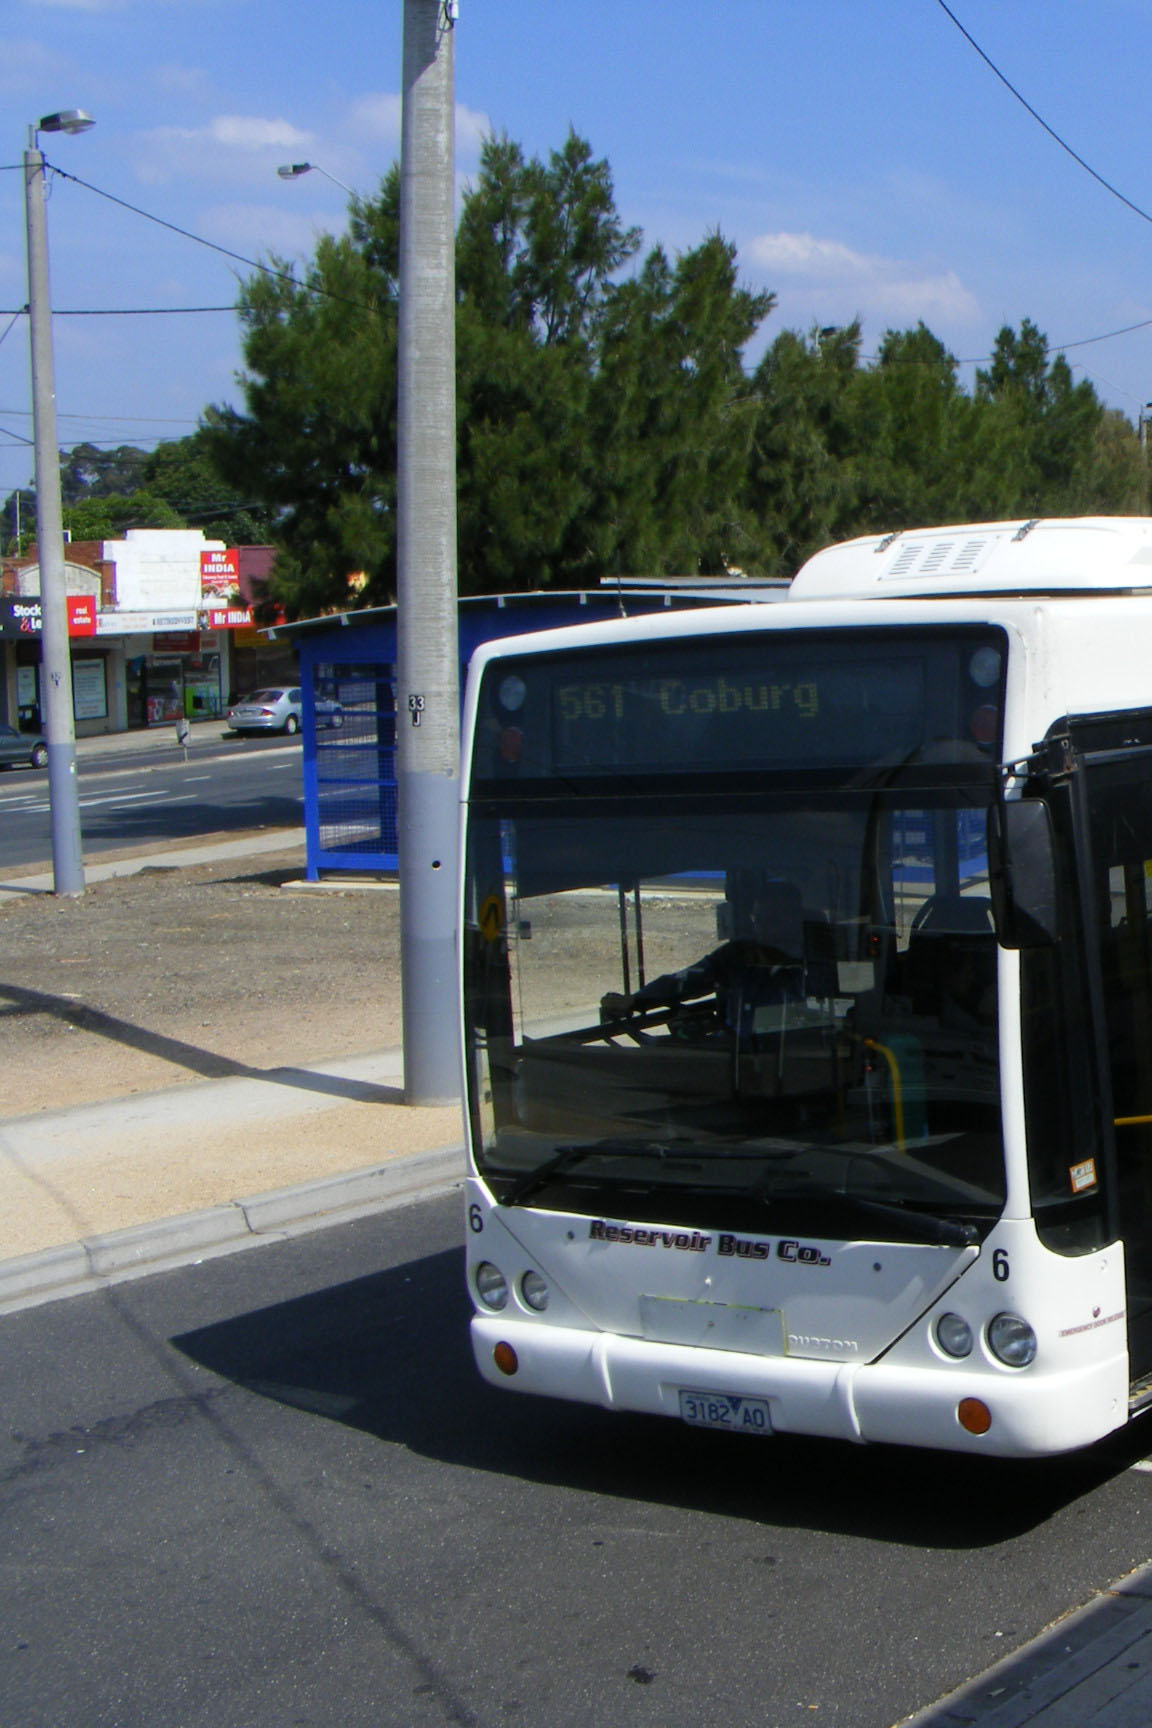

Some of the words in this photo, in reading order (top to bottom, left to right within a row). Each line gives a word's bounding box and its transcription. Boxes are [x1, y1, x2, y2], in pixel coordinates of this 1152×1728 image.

[211, 554, 227, 562] Mr
[204, 564, 234, 572] INDIA
[13, 604, 42, 617] Stock
[214, 612, 226, 624] Mr
[228, 610, 251, 623] INDIA
[20, 617, 35, 633] &
[409, 696, 424, 710] 33
[559, 683, 624, 720] 561
[660, 679, 820, 717] Coburg
[469, 1203, 484, 1234] 6
[589, 1220, 712, 1252] Reservoir
[717, 1234, 770, 1259] Bus
[777, 1240, 832, 1266] Co.
[993, 1248, 1010, 1283] 6
[686, 1400, 731, 1424] 3182
